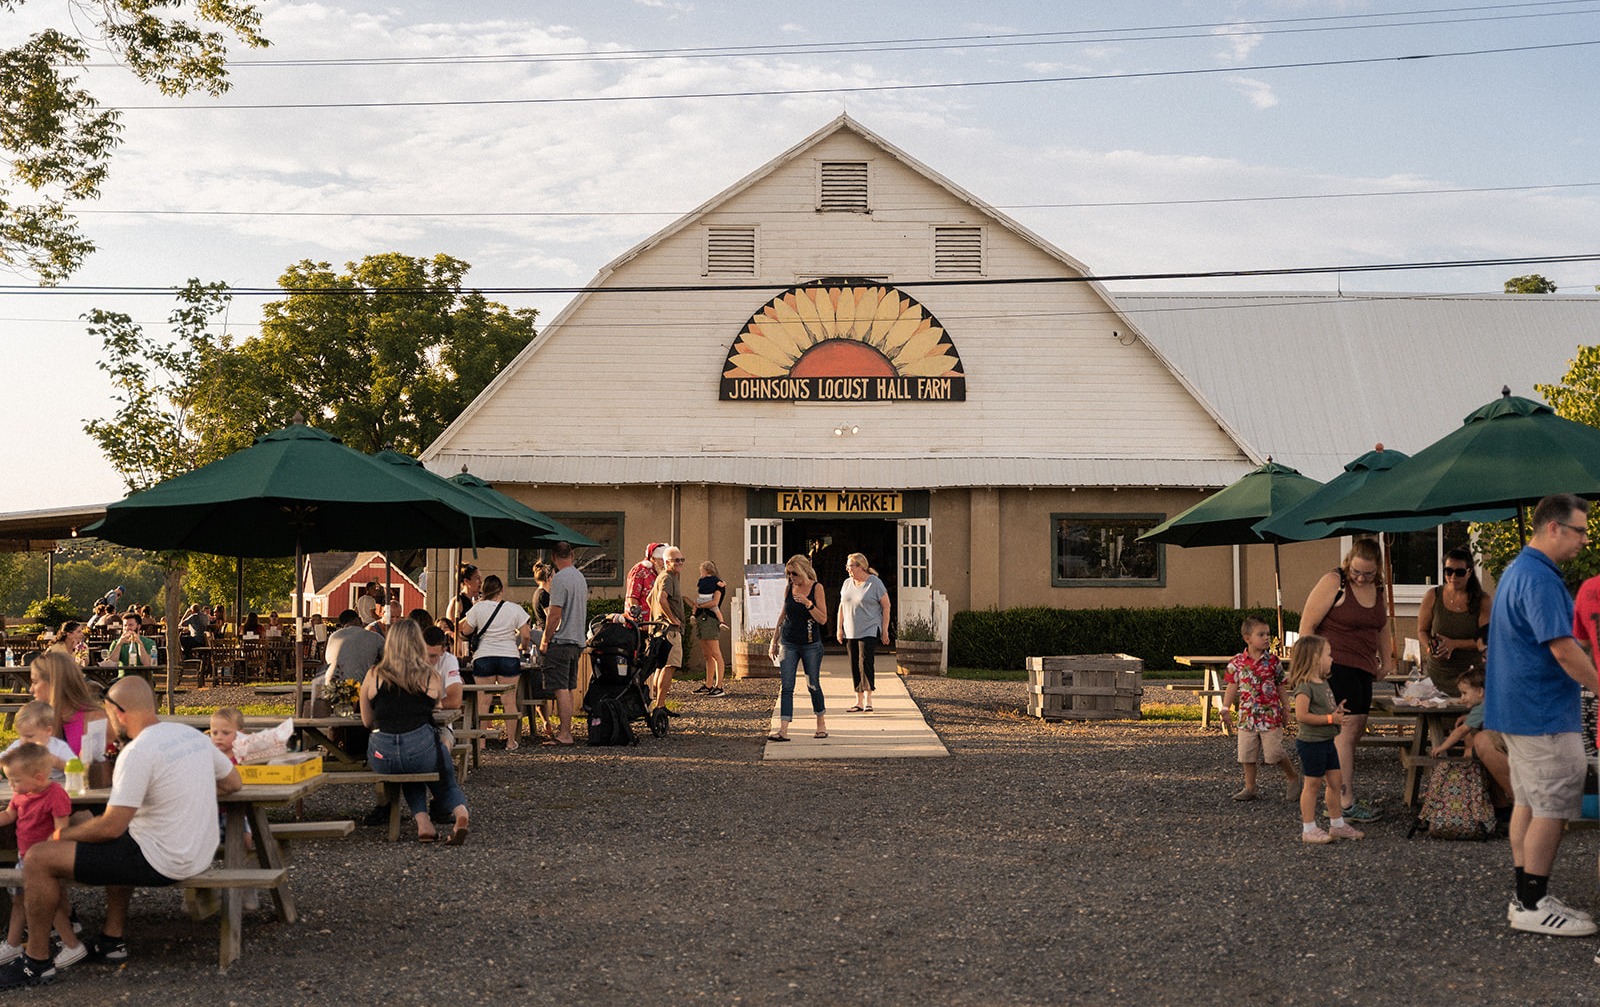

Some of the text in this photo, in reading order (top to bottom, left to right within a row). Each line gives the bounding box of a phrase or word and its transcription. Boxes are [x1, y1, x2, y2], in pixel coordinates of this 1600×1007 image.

[818, 378, 869, 399] LOCUST
[876, 378, 912, 399] HALL
[917, 378, 951, 400] FARM
[782, 493, 899, 511] FARM MARKET
